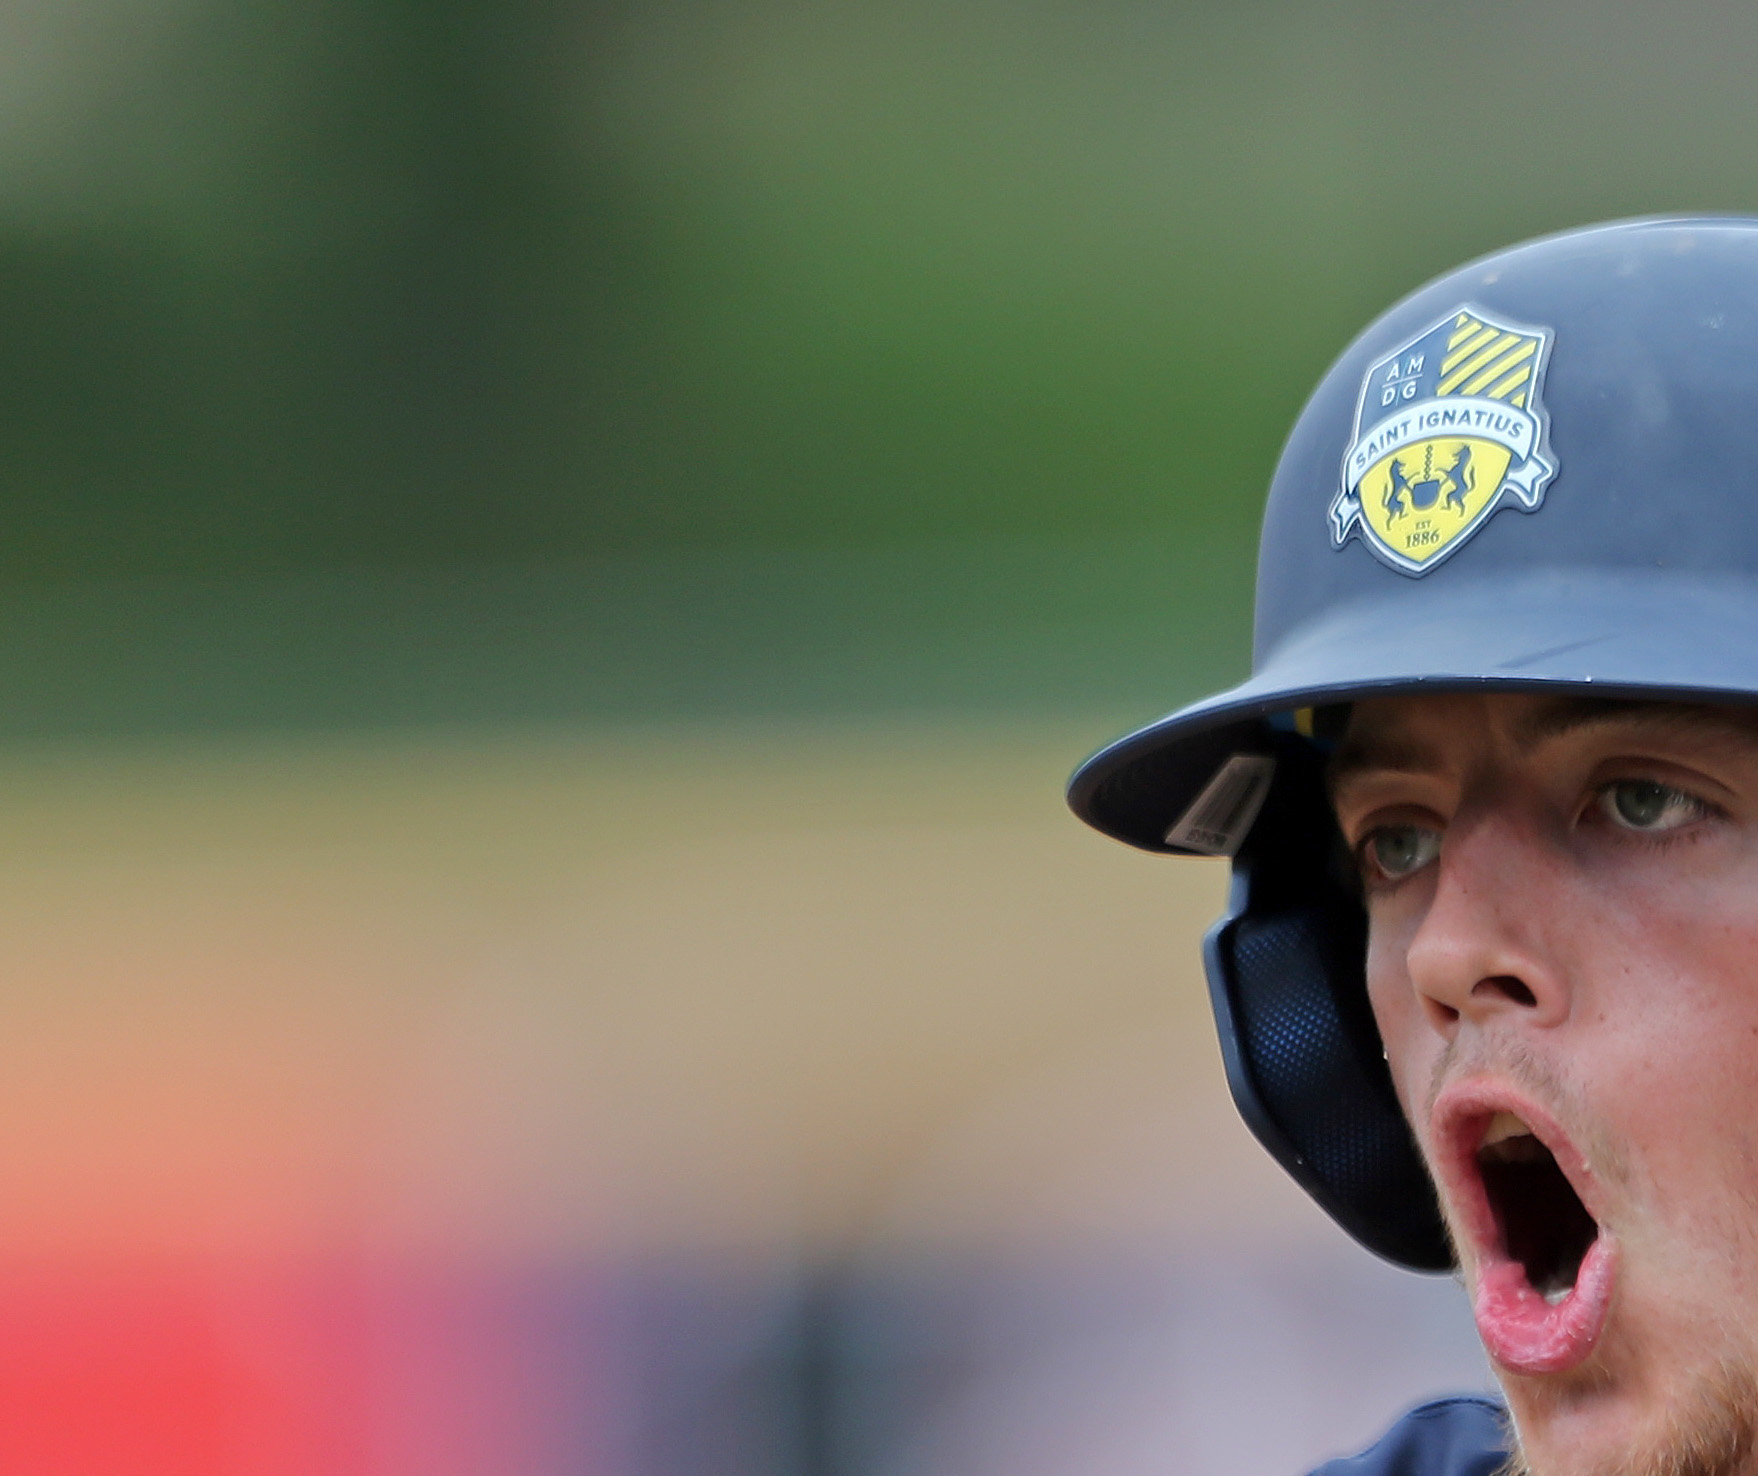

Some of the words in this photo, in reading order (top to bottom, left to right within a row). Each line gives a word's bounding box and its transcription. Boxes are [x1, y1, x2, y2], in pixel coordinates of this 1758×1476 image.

[1355, 419, 1411, 470] SAINT
[1418, 408, 1524, 438] IGNATIUS
[1406, 528, 1440, 548] 1886
